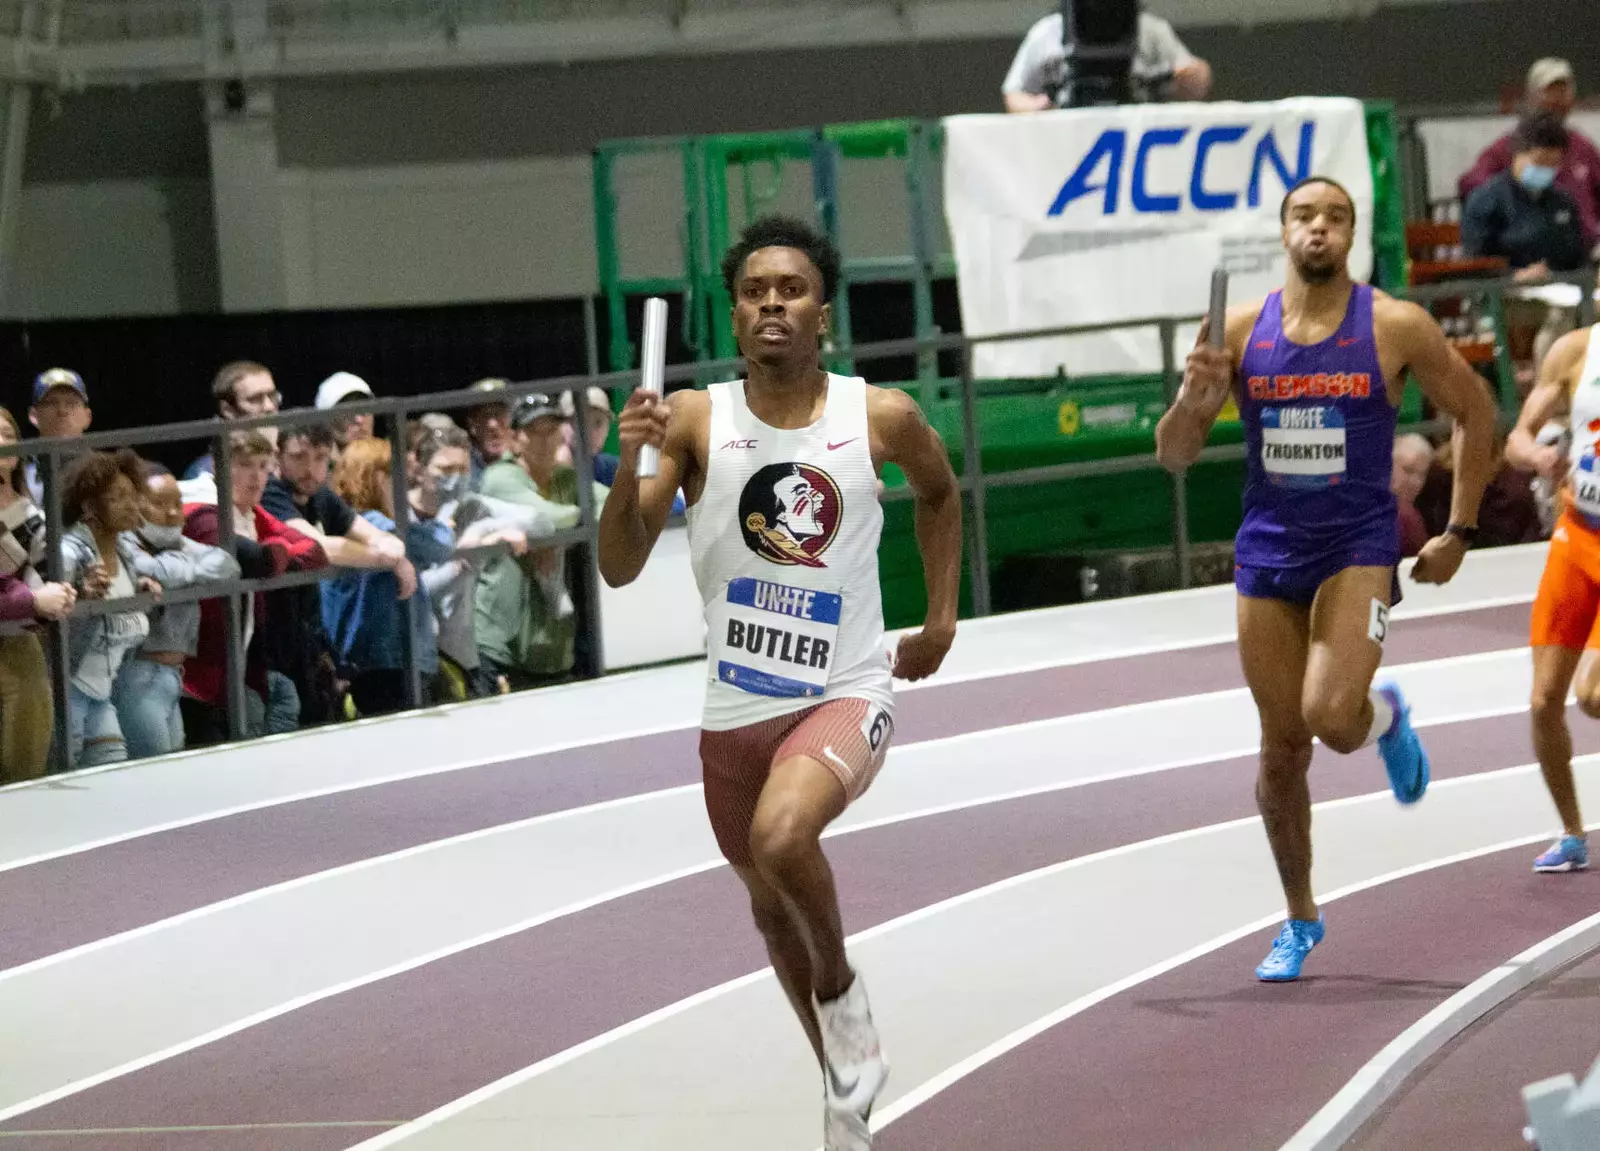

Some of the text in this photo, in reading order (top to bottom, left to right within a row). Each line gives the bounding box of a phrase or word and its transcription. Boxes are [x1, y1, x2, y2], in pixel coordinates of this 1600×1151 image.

[1046, 120, 1316, 217] ACCN
[1247, 372, 1372, 400] CLEMSON
[1279, 407, 1326, 429] UNITE
[720, 438, 759, 450] ACC
[1265, 443, 1345, 461] THORNTON
[1579, 481, 1600, 504] LA
[754, 582, 816, 620] UNITE
[1375, 605, 1388, 642] 5
[726, 618, 830, 669] BUTLER
